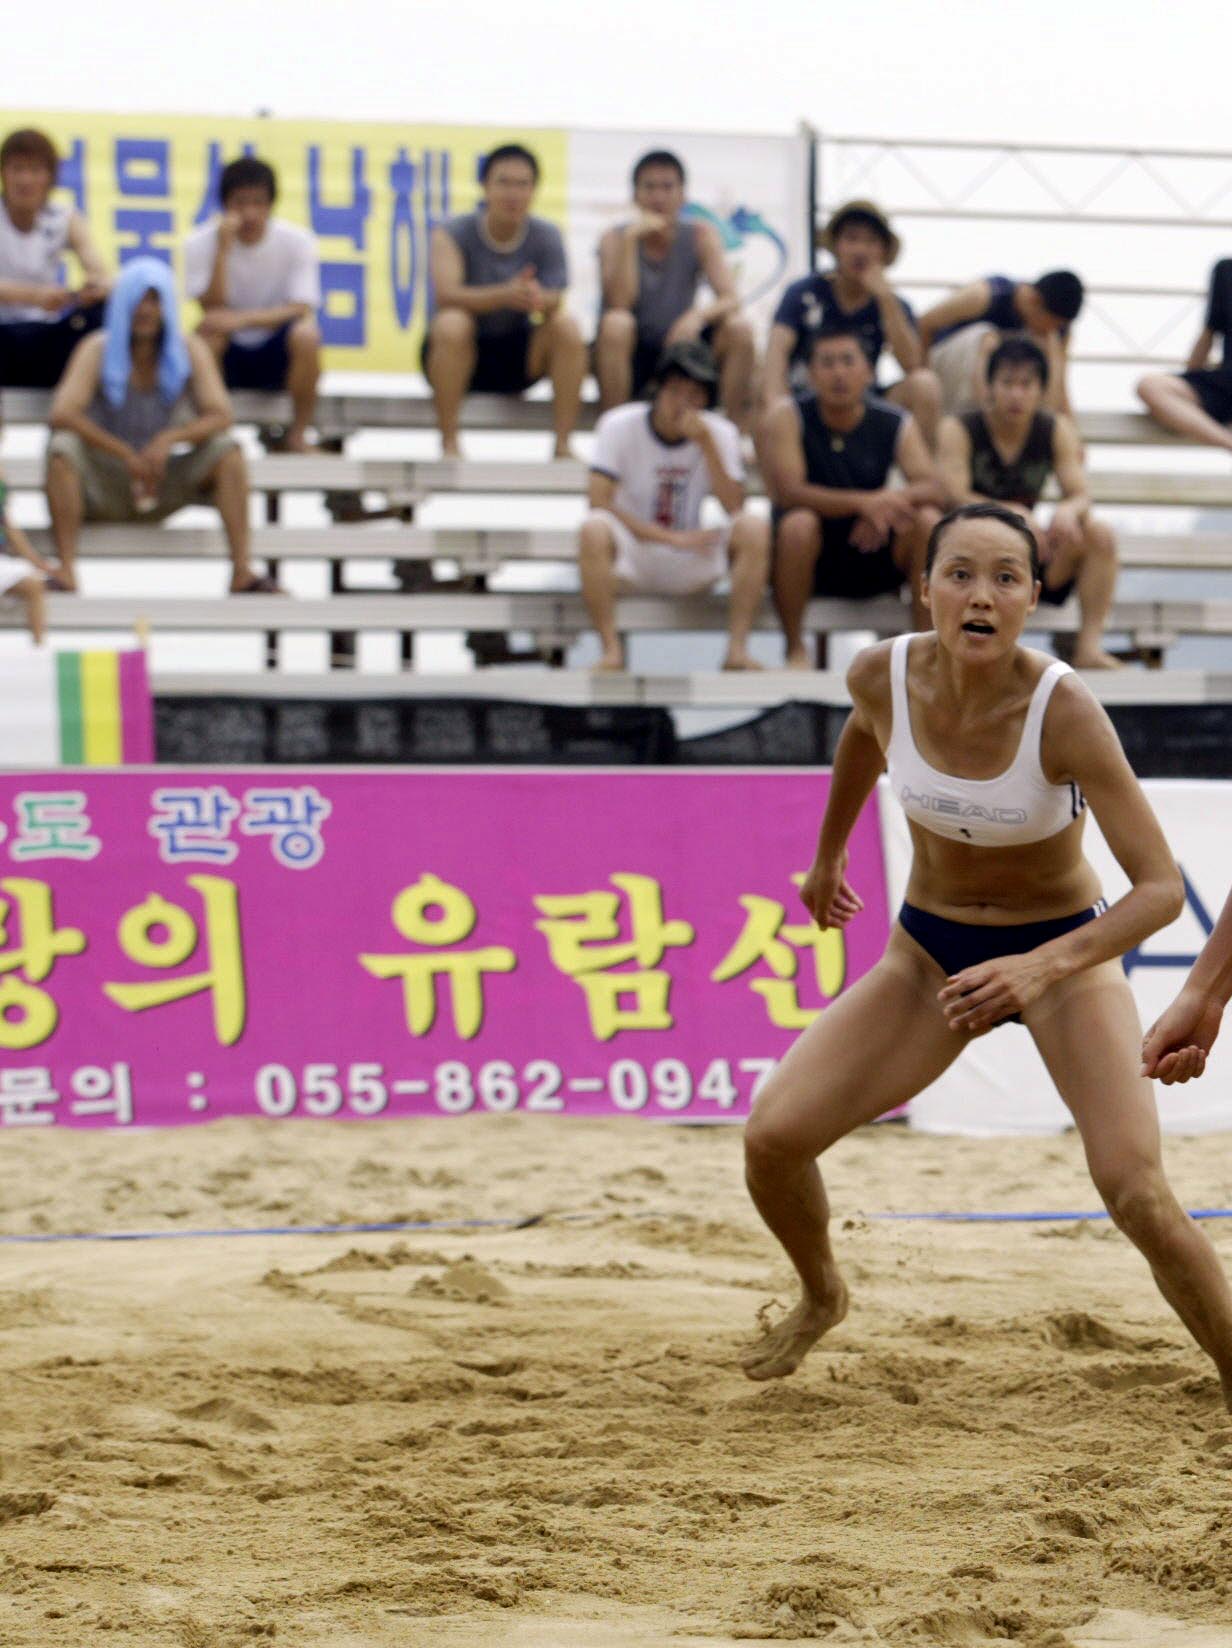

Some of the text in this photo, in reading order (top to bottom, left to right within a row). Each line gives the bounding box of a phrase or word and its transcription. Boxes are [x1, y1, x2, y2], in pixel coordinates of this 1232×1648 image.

[0, 785, 332, 870] 도 관광
[901, 785, 1028, 825] HEAD
[361, 873, 846, 1041] 유람선
[254, 1057, 777, 1117] 055-862-0947
